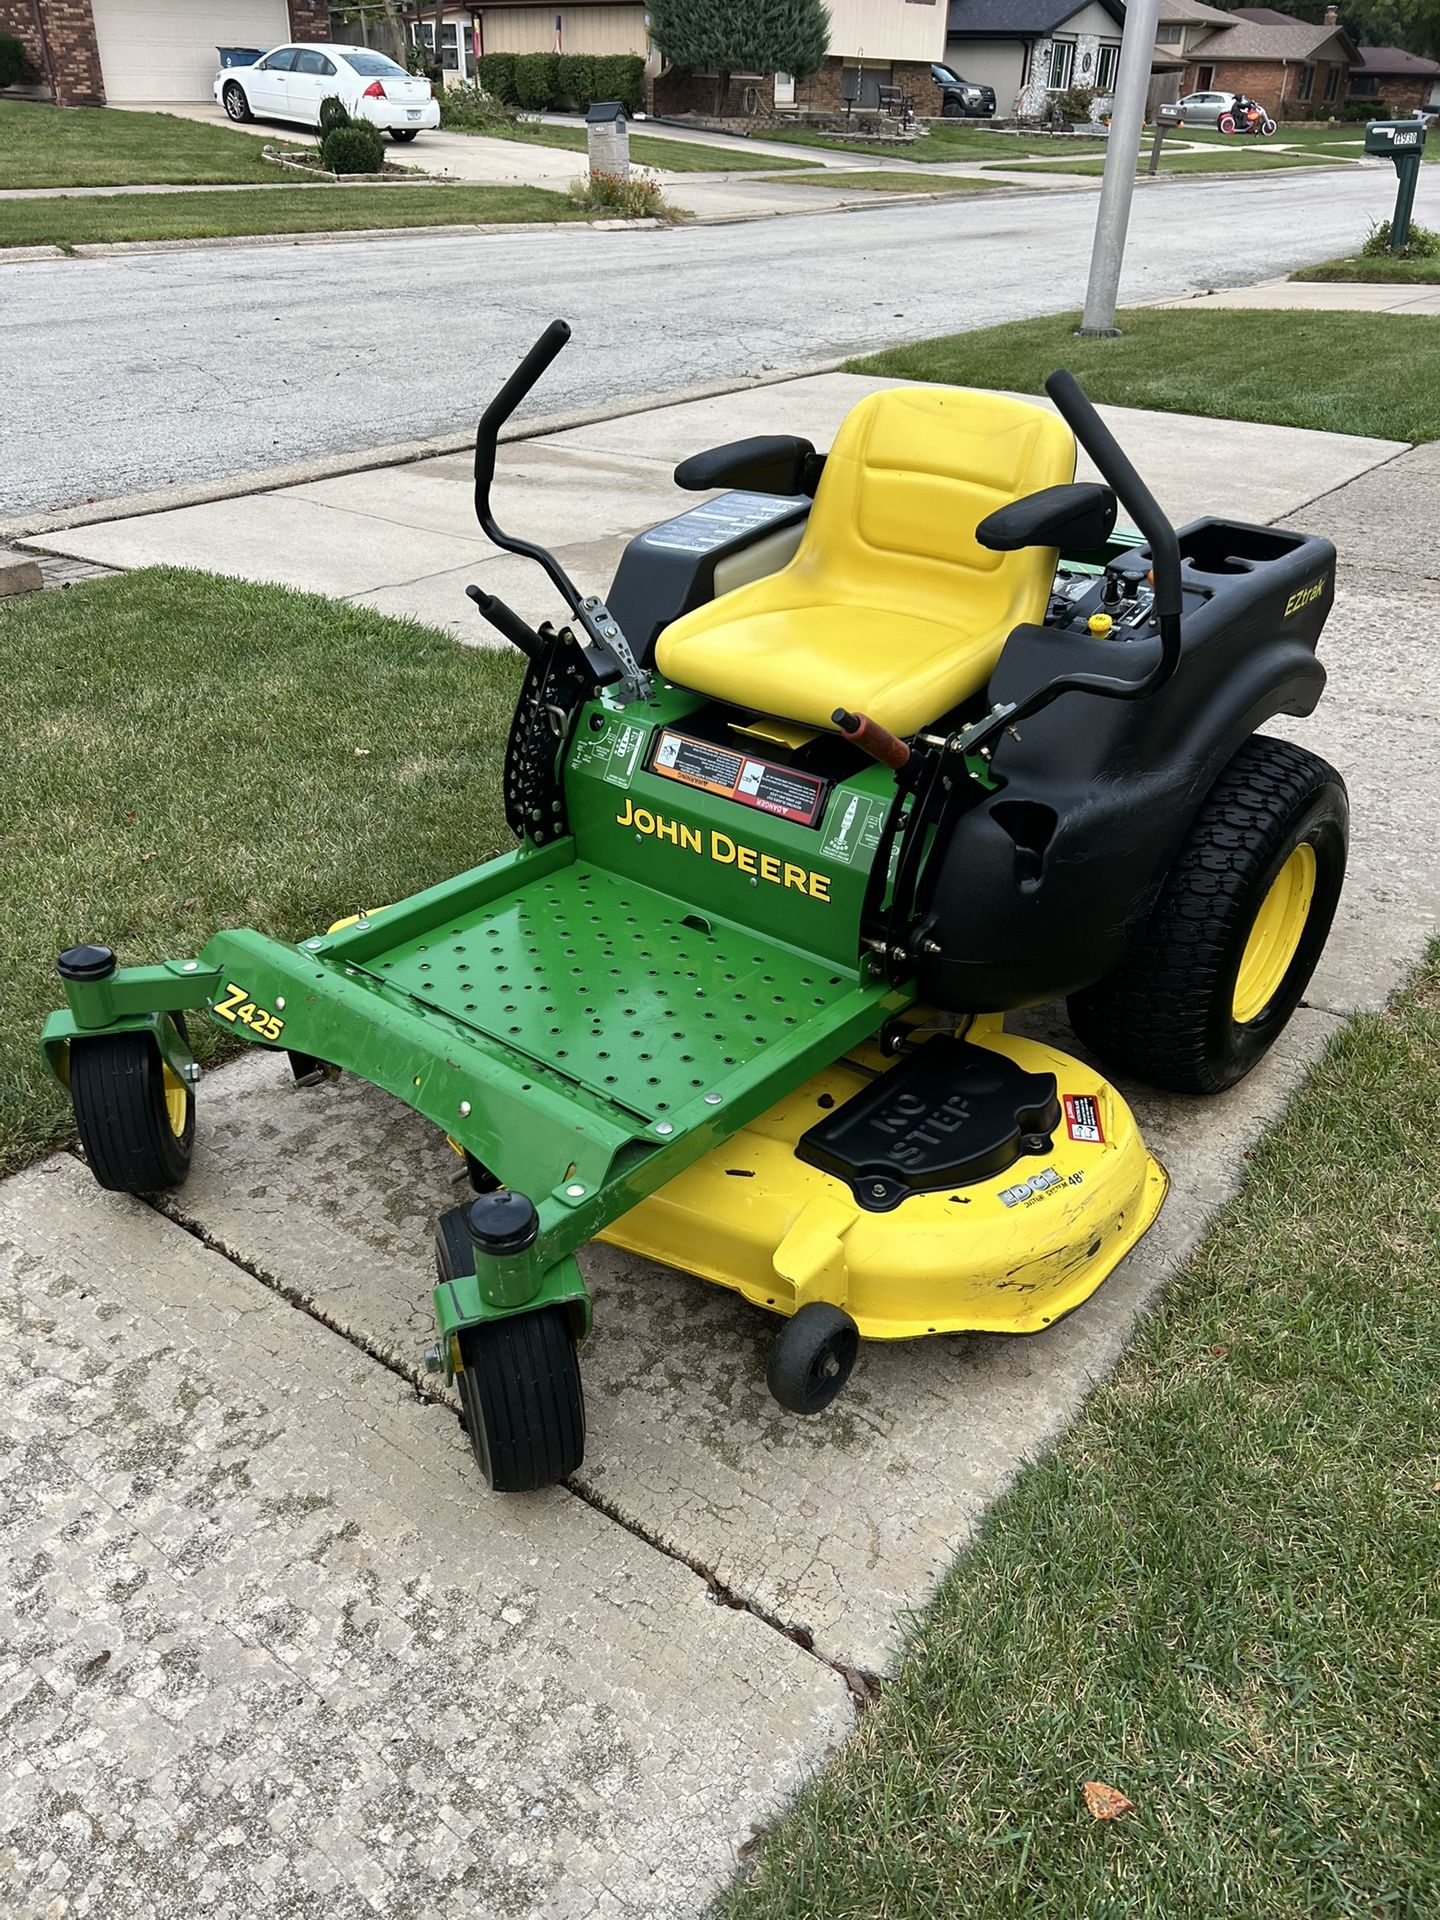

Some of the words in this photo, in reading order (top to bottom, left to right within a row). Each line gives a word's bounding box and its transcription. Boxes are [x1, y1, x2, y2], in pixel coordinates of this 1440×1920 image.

[1283, 578, 1325, 617] EZtrak
[756, 798, 783, 813] DANGER
[616, 798, 702, 854] JOHN
[711, 829, 831, 903] DEERE
[212, 982, 285, 1041] Z425
[868, 1093, 927, 1134] NO
[886, 1095, 971, 1166] STEP
[997, 1166, 1064, 1209] EDGE
[1068, 1169, 1085, 1186] 48"
